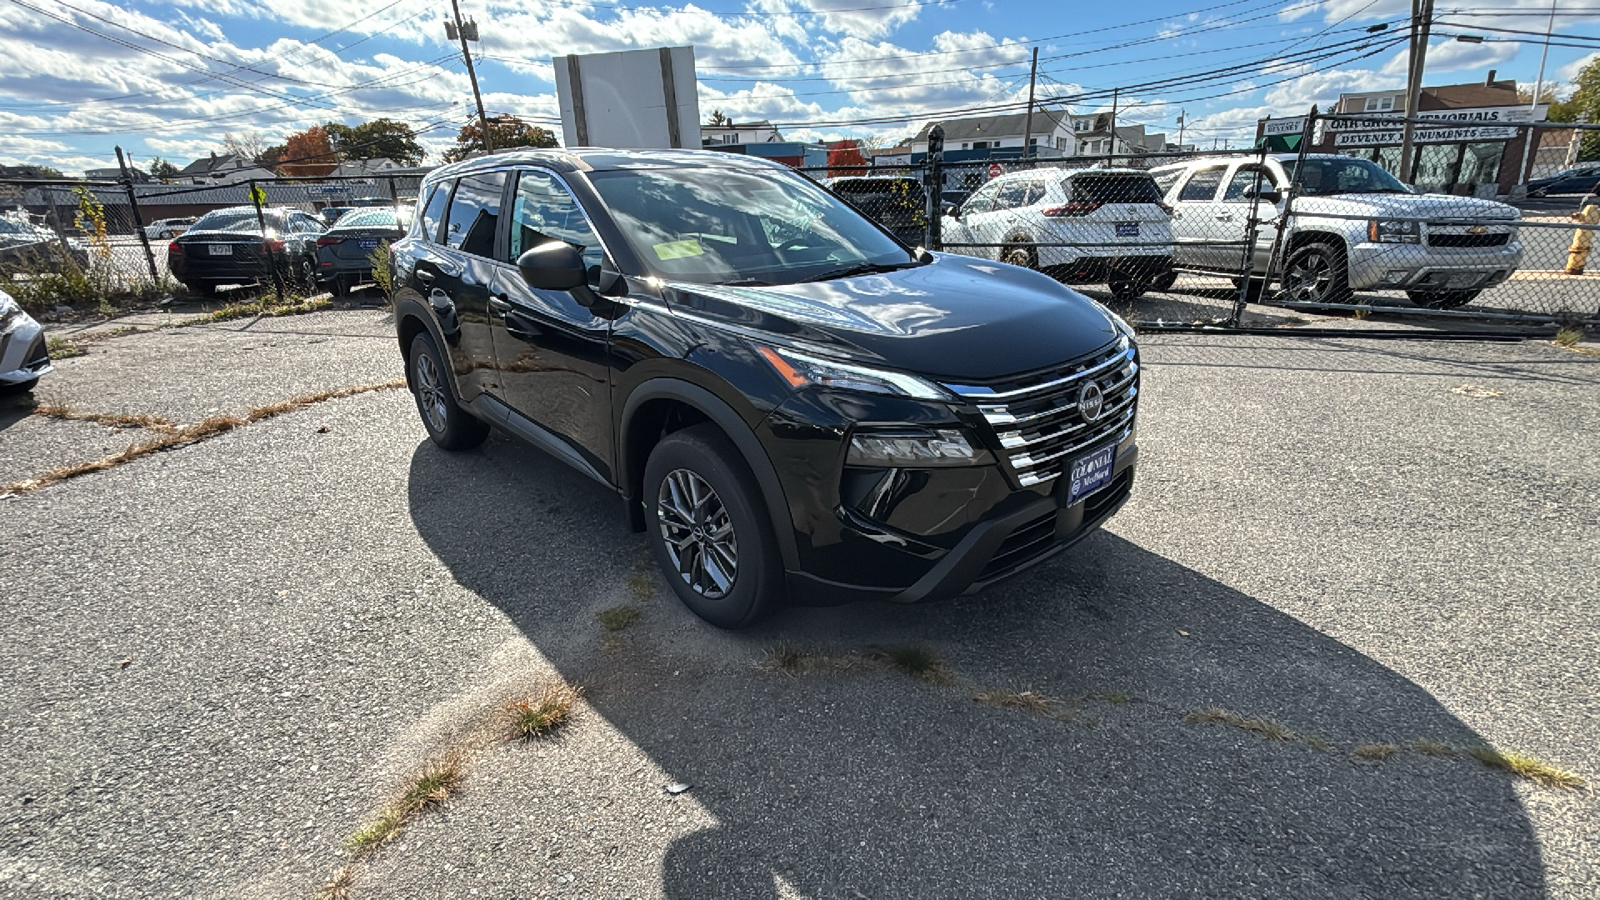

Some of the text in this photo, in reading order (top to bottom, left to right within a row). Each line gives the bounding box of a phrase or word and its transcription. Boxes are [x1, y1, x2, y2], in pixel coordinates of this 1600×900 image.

[1268, 124, 1299, 133] DEVENEY
[1341, 133, 1396, 143] DEVENEY
[1083, 467, 1109, 487] Medford
